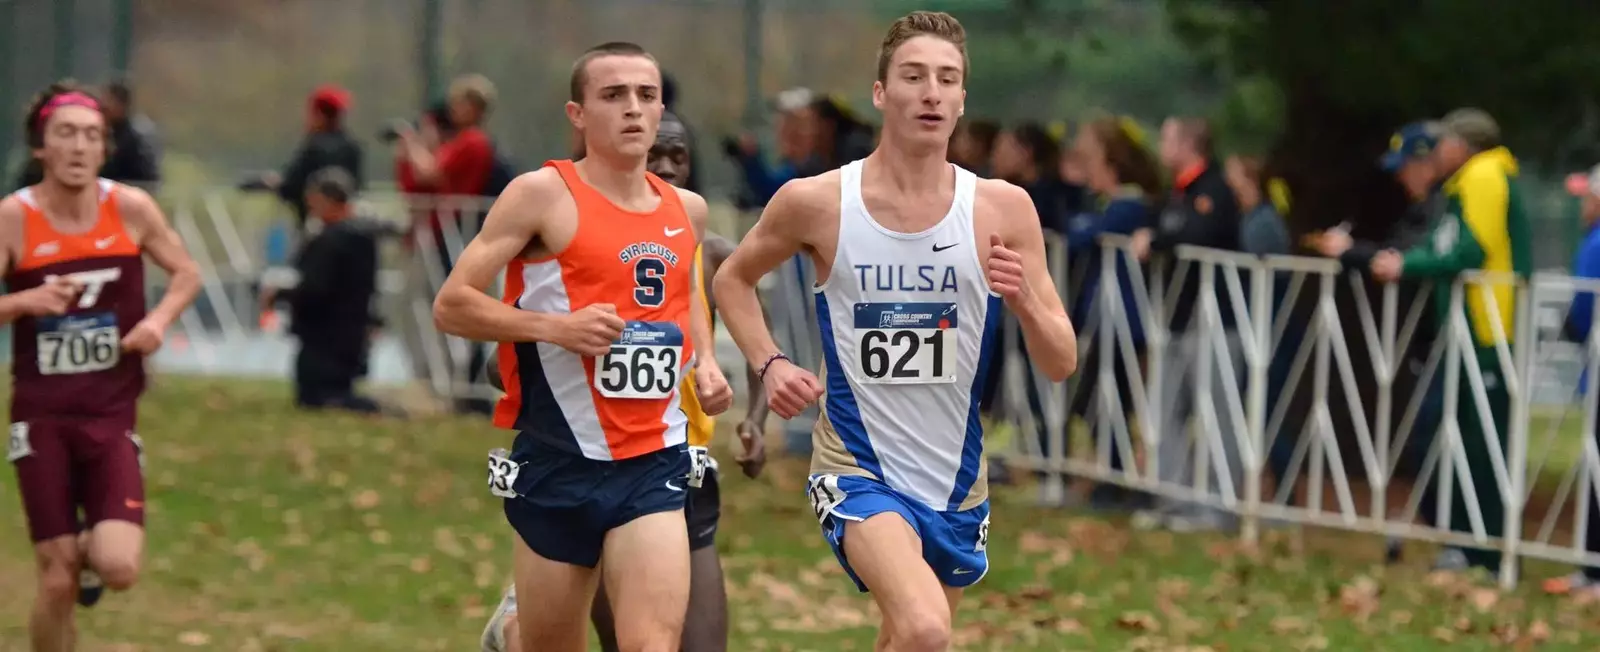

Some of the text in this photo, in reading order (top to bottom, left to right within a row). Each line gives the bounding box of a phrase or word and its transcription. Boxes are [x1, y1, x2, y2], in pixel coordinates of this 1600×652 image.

[618, 241, 679, 267] SYRACUSE
[633, 256, 666, 308] S
[854, 264, 958, 292] TULSA
[44, 331, 112, 368] 706
[601, 346, 677, 394] 563
[861, 329, 943, 378] 621
